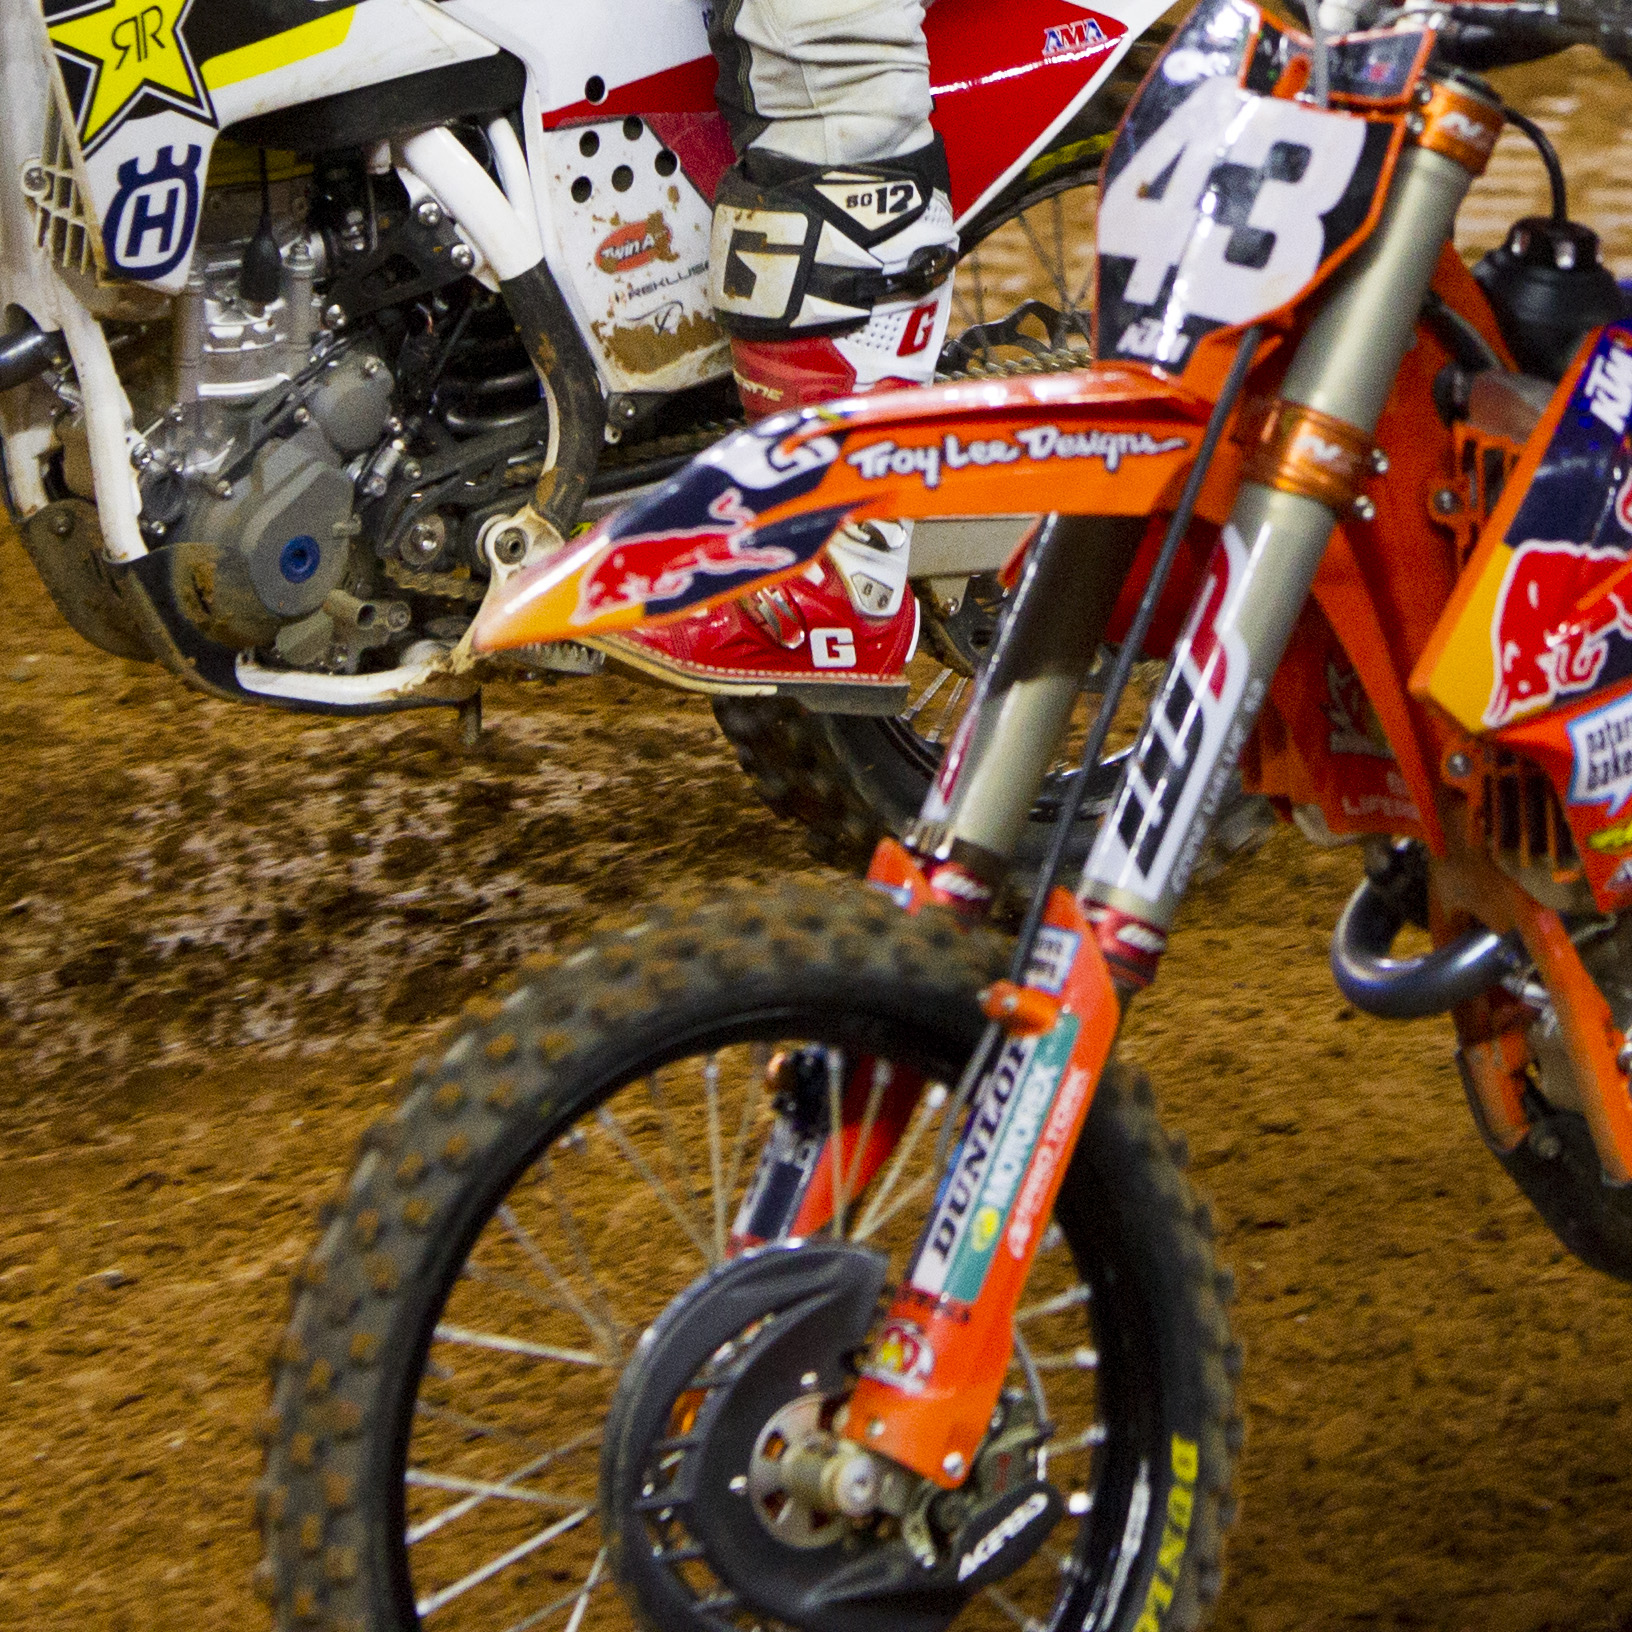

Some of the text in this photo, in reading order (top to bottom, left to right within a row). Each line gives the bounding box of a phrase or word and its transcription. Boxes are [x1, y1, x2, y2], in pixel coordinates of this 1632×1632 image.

[1042, 18, 1108, 58] AMA
[1098, 74, 1368, 328] 43
[849, 424, 1188, 489] Troy Lee Designs
[981, 1062, 1063, 1210] MOTOREX
